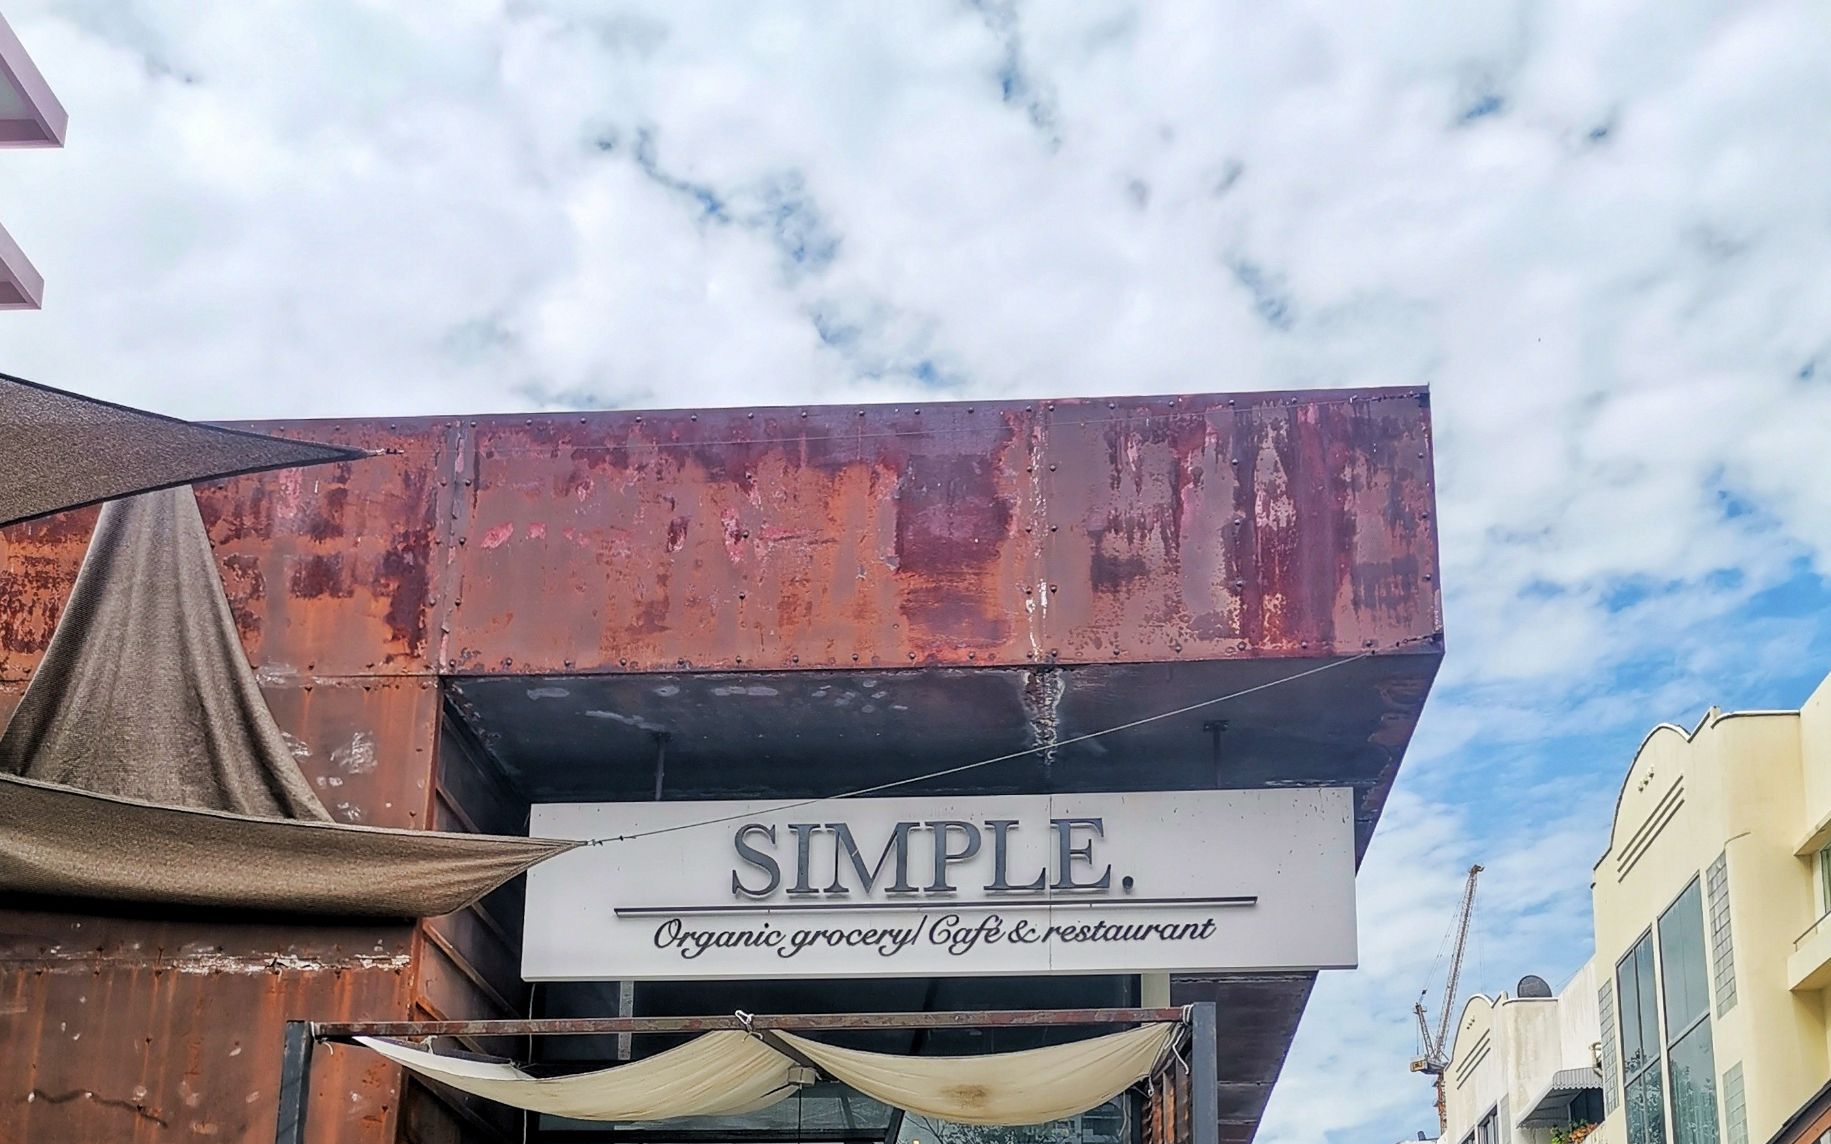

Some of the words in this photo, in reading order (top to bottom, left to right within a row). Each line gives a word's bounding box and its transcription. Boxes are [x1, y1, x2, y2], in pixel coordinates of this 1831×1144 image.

[732, 817, 1134, 896] SIMPLE.
[653, 918, 786, 959] Organic
[928, 914, 1006, 956] Café
[1007, 919, 1040, 944] &
[1041, 917, 1217, 943] restaurant
